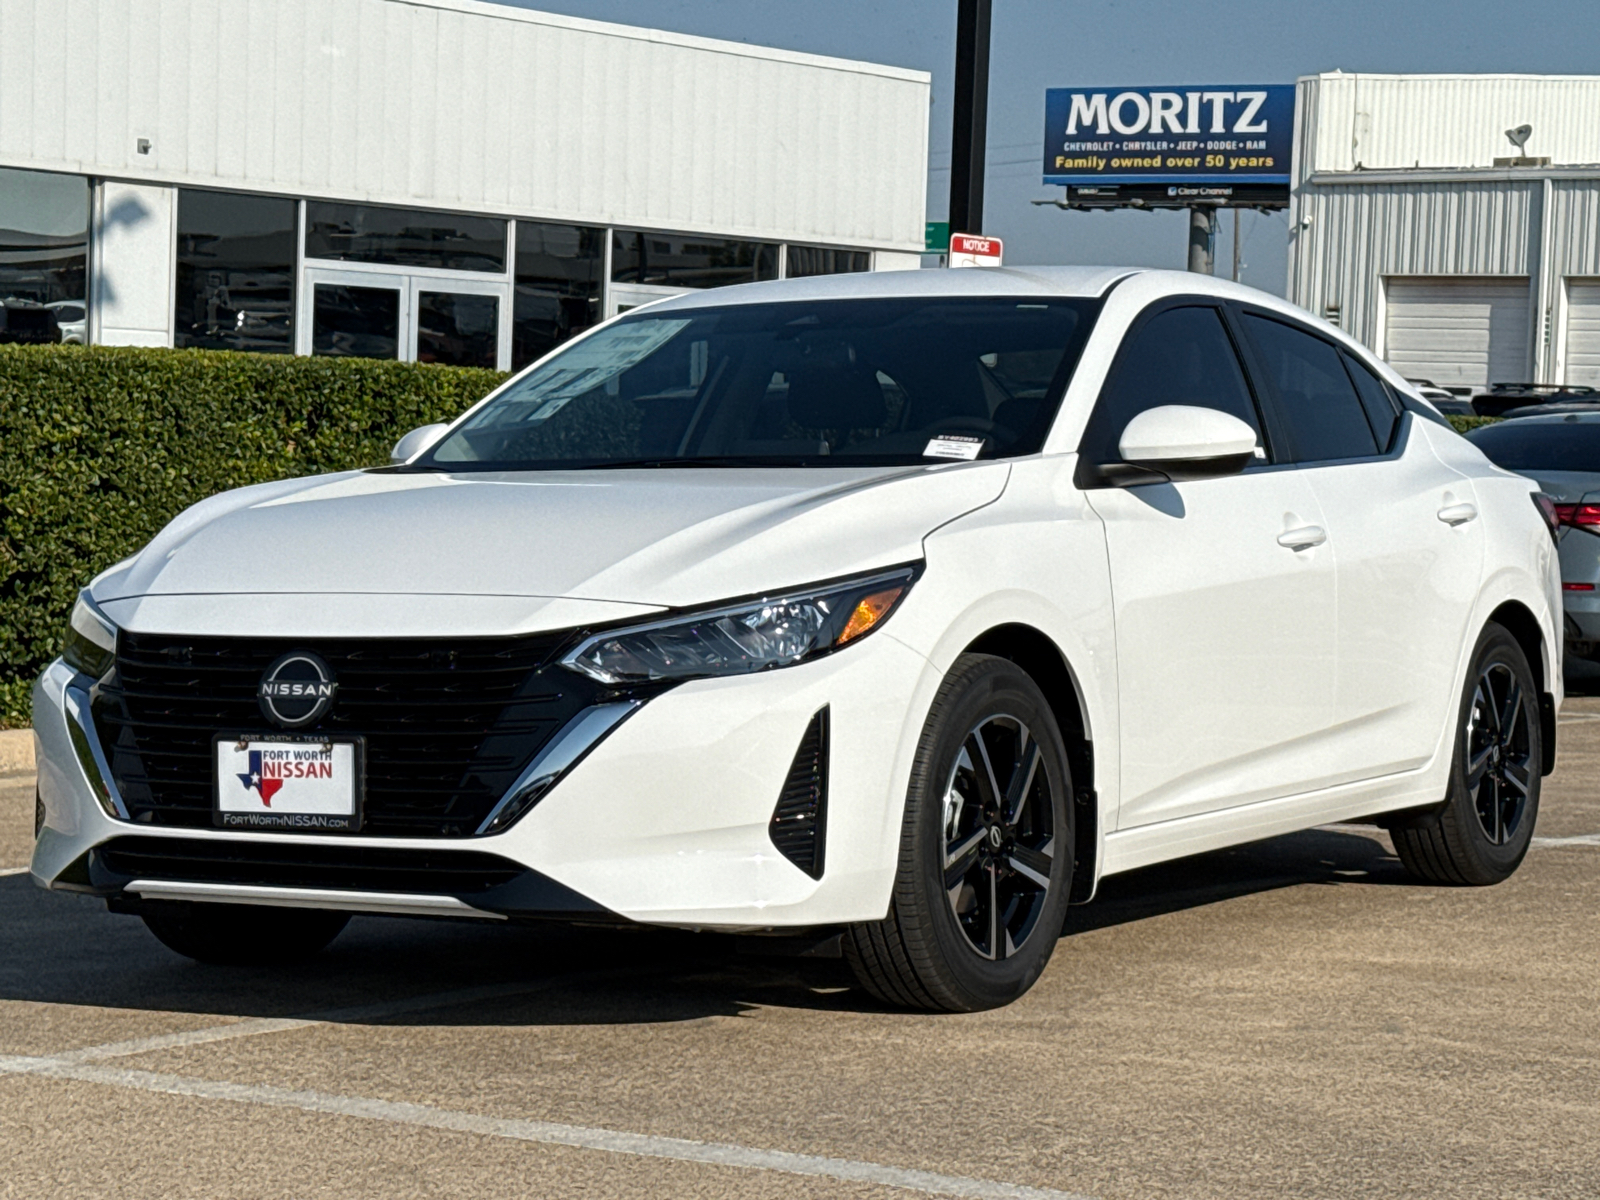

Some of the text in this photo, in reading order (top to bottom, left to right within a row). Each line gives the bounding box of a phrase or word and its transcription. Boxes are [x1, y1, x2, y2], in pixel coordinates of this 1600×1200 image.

[1065, 91, 1268, 135] MORITZ
[1064, 140, 1267, 151] CHEVROLET CHRYSLER JEEP DODGE RAM
[1055, 155, 1274, 170] Family owned over 50 years
[1177, 187, 1233, 195] Clear Channel
[962, 239, 990, 252] NOTICE
[262, 683, 331, 695] NISSAN
[263, 734, 292, 742] WORTH
[263, 750, 332, 761] FORT WORTH
[263, 762, 332, 778] NISSAN
